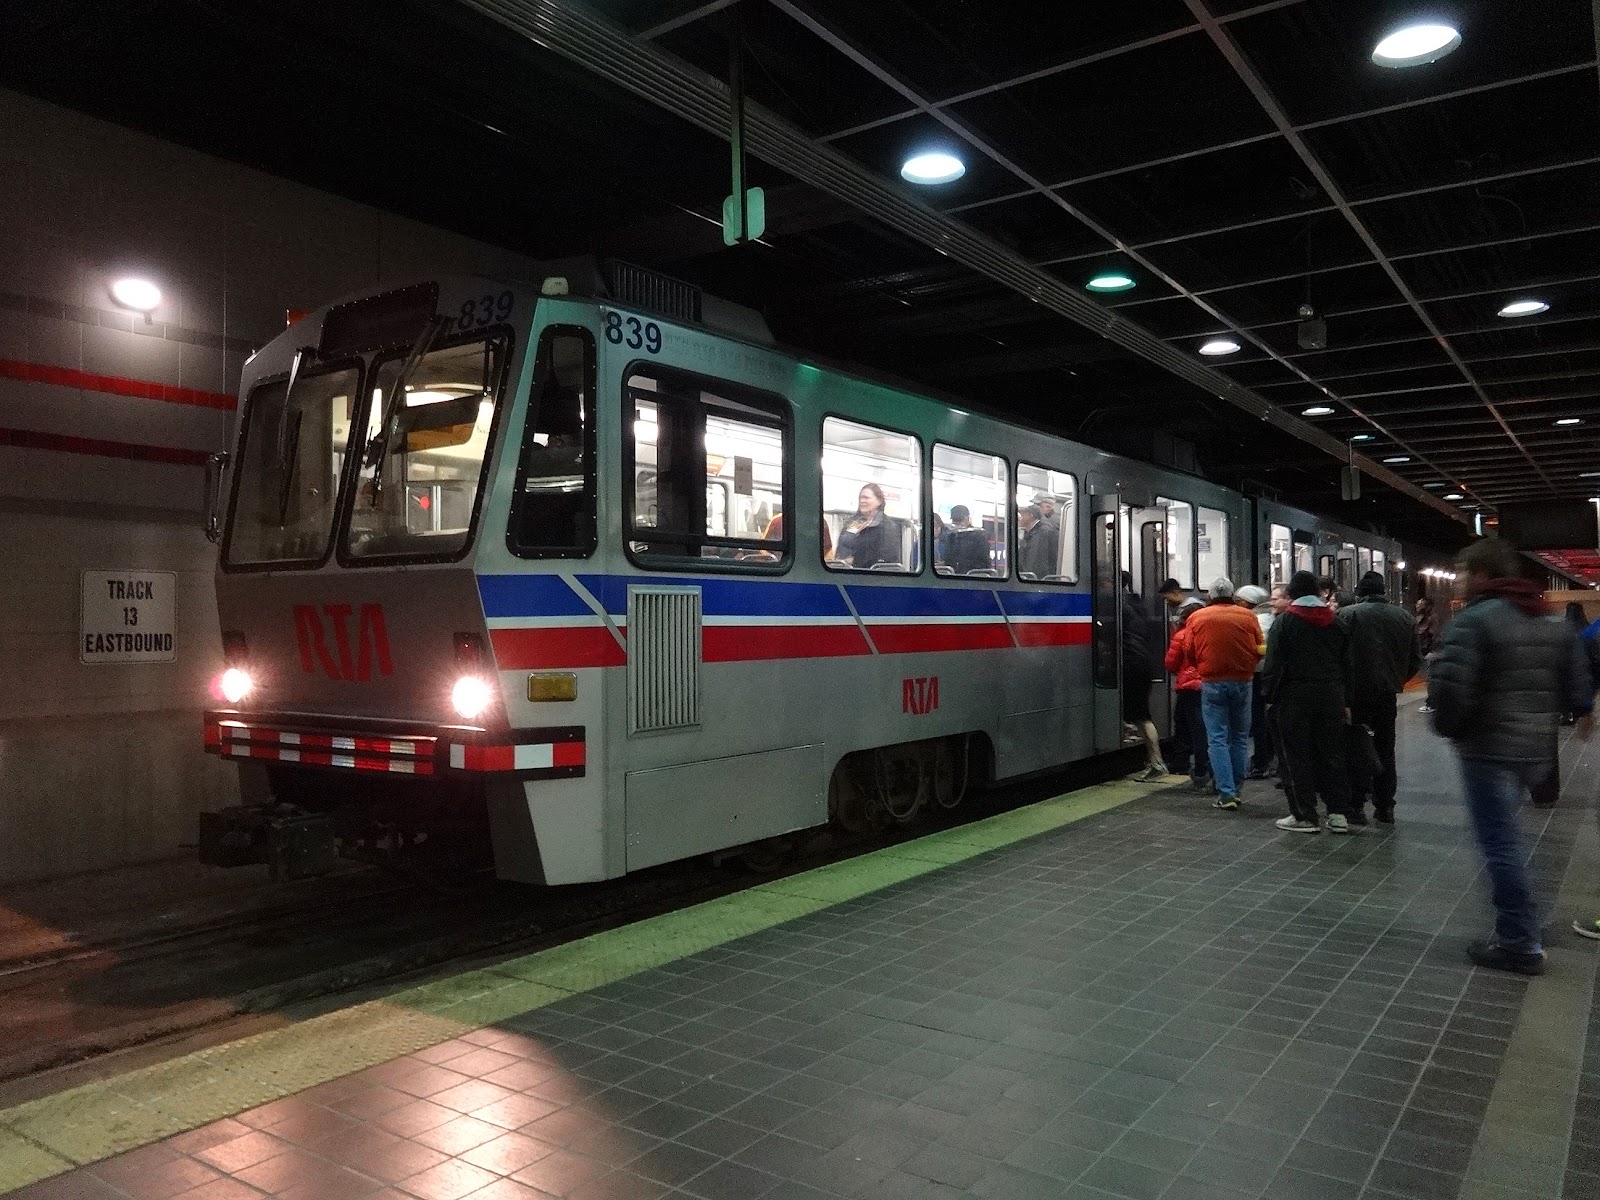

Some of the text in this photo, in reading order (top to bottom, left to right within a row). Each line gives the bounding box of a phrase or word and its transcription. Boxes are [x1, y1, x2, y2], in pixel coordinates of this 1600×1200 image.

[457, 290, 515, 331] 839
[605, 311, 662, 354] 839
[107, 580, 153, 600] TRACK
[123, 606, 138, 626] 13
[85, 633, 173, 653] EASTBOUND
[293, 603, 394, 682] RTA
[902, 676, 939, 715] RTA
